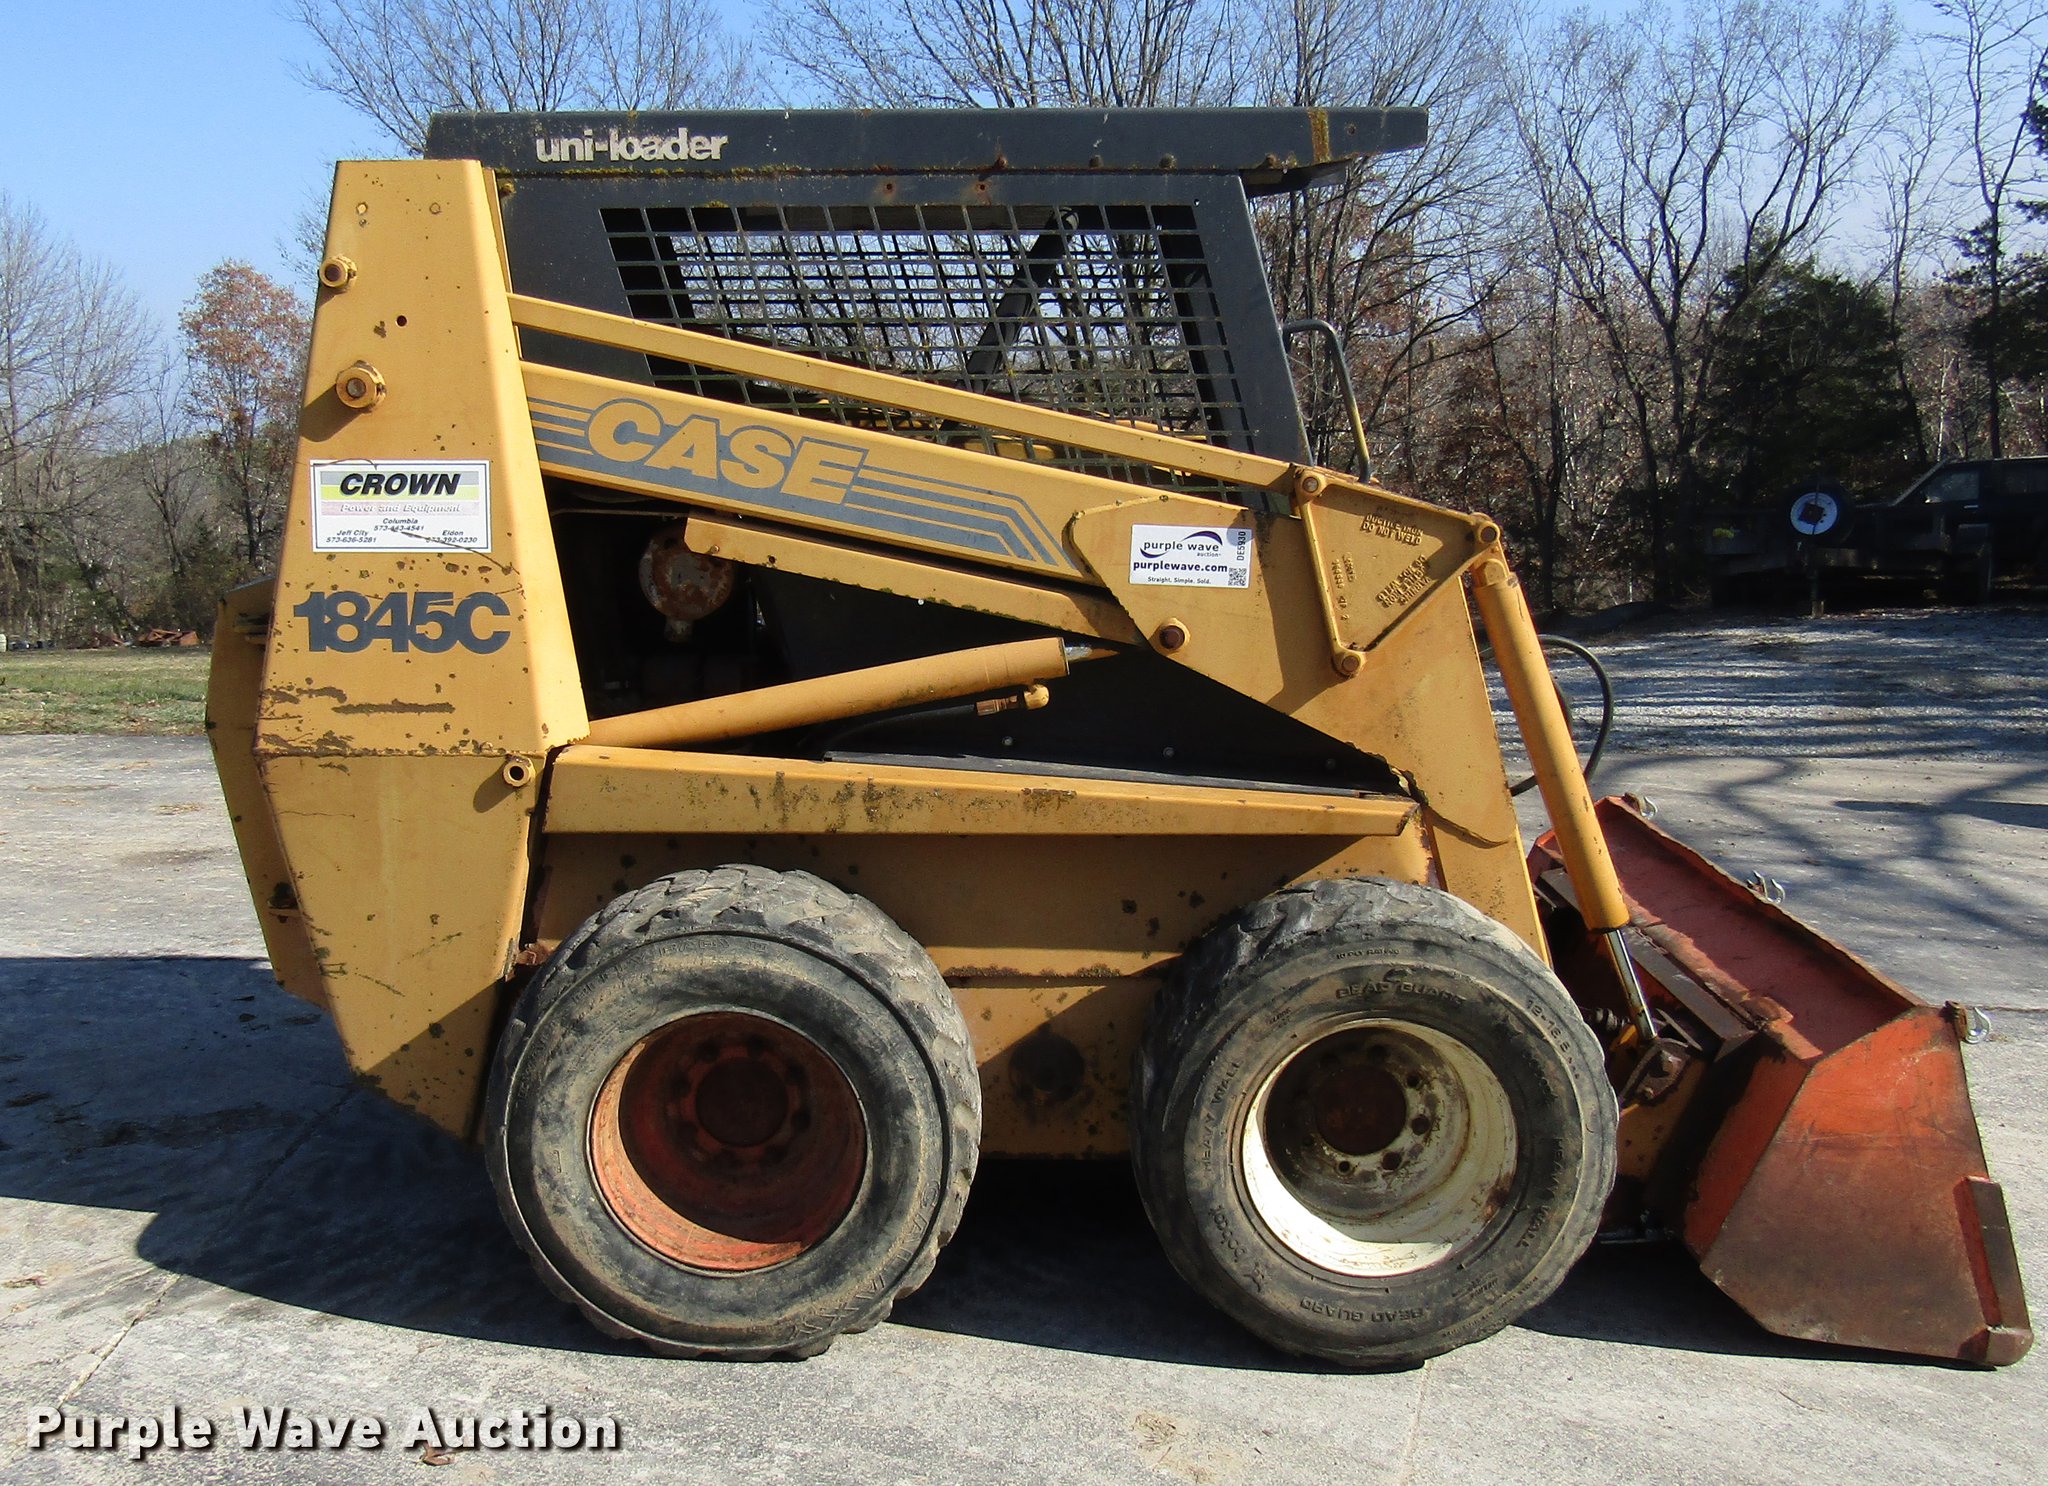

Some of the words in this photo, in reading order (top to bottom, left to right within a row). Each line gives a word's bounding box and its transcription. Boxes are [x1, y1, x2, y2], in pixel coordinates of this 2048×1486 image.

[536, 127, 728, 163] uni-loader
[585, 398, 870, 505] CASE
[340, 473, 461, 496] CROWN
[341, 504, 375, 513] Power
[378, 504, 399, 513] and
[403, 504, 461, 514] Equipment
[353, 530, 369, 538] City
[1143, 541, 1183, 552] purple
[1236, 531, 1246, 561] DE5930
[1133, 561, 1228, 573] purplewave.com
[1147, 576, 1172, 584] Straight.
[294, 590, 511, 655] 1845C
